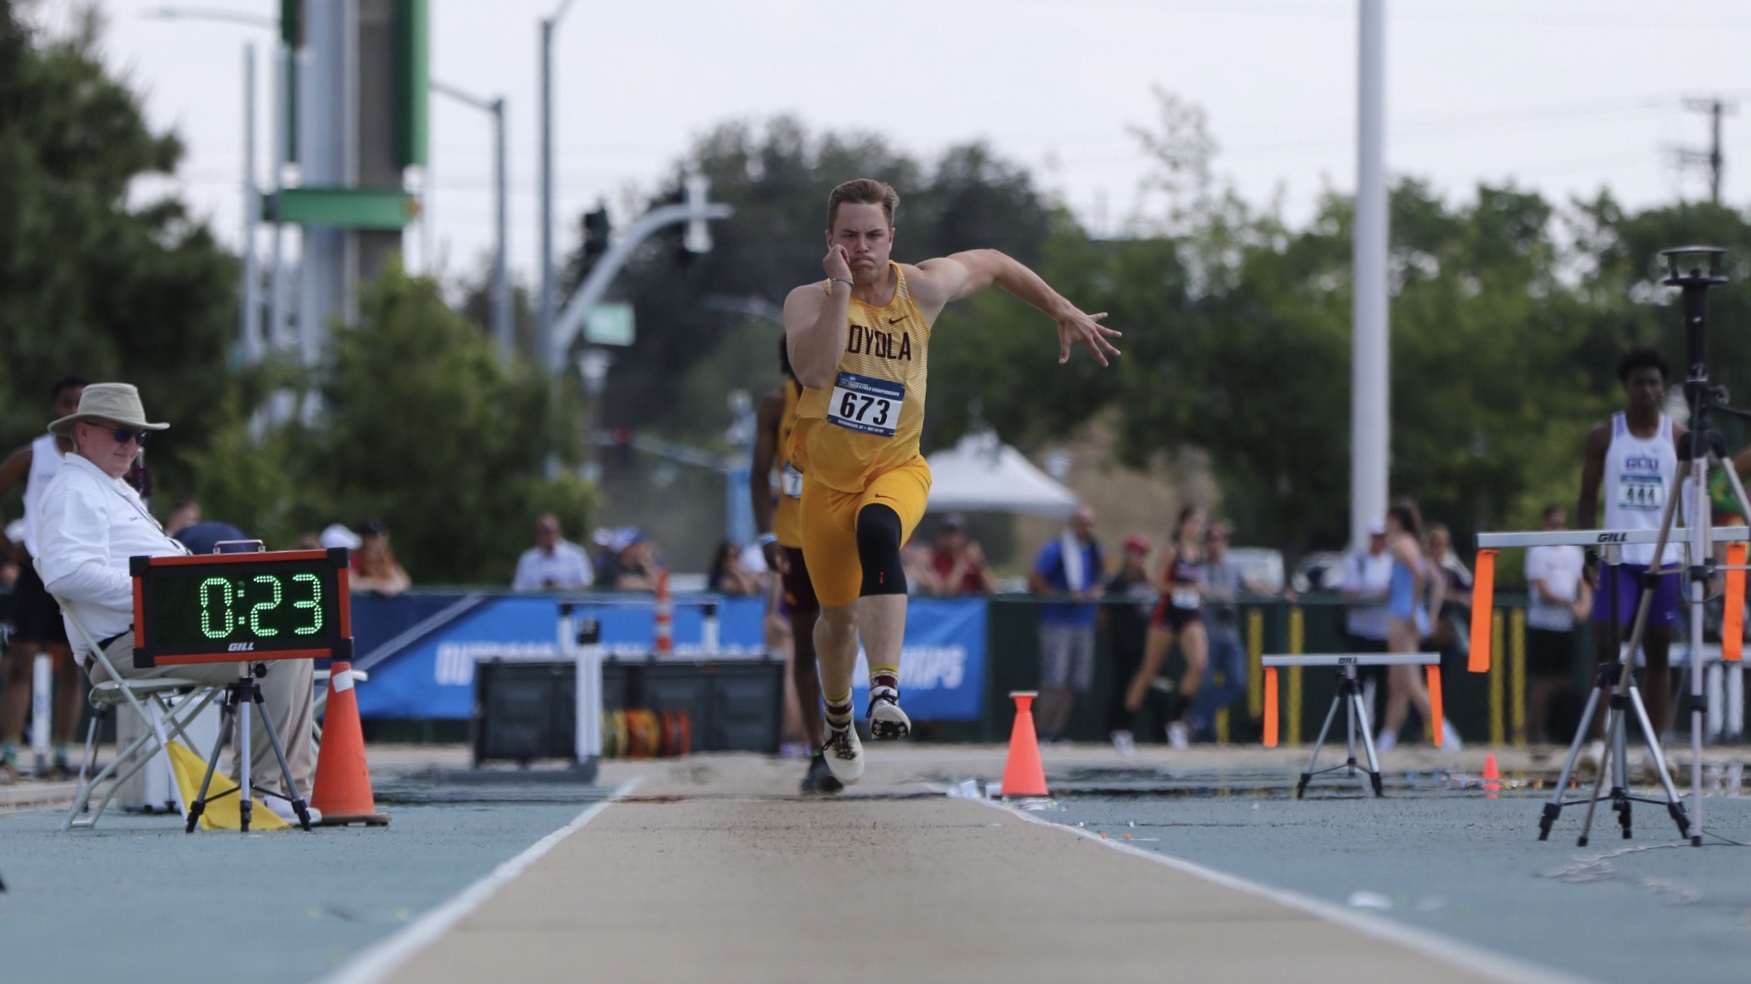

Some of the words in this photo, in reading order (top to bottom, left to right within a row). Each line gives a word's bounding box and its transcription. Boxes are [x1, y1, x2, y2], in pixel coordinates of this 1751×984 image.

[845, 324, 911, 361] OYOLA
[840, 392, 890, 426] 673
[1625, 457, 1659, 472] GCU
[1627, 484, 1655, 505] 444
[1597, 532, 1627, 543] GILL
[200, 573, 323, 639] 0:23
[228, 642, 254, 652] GILL
[1338, 657, 1358, 665] GILL
